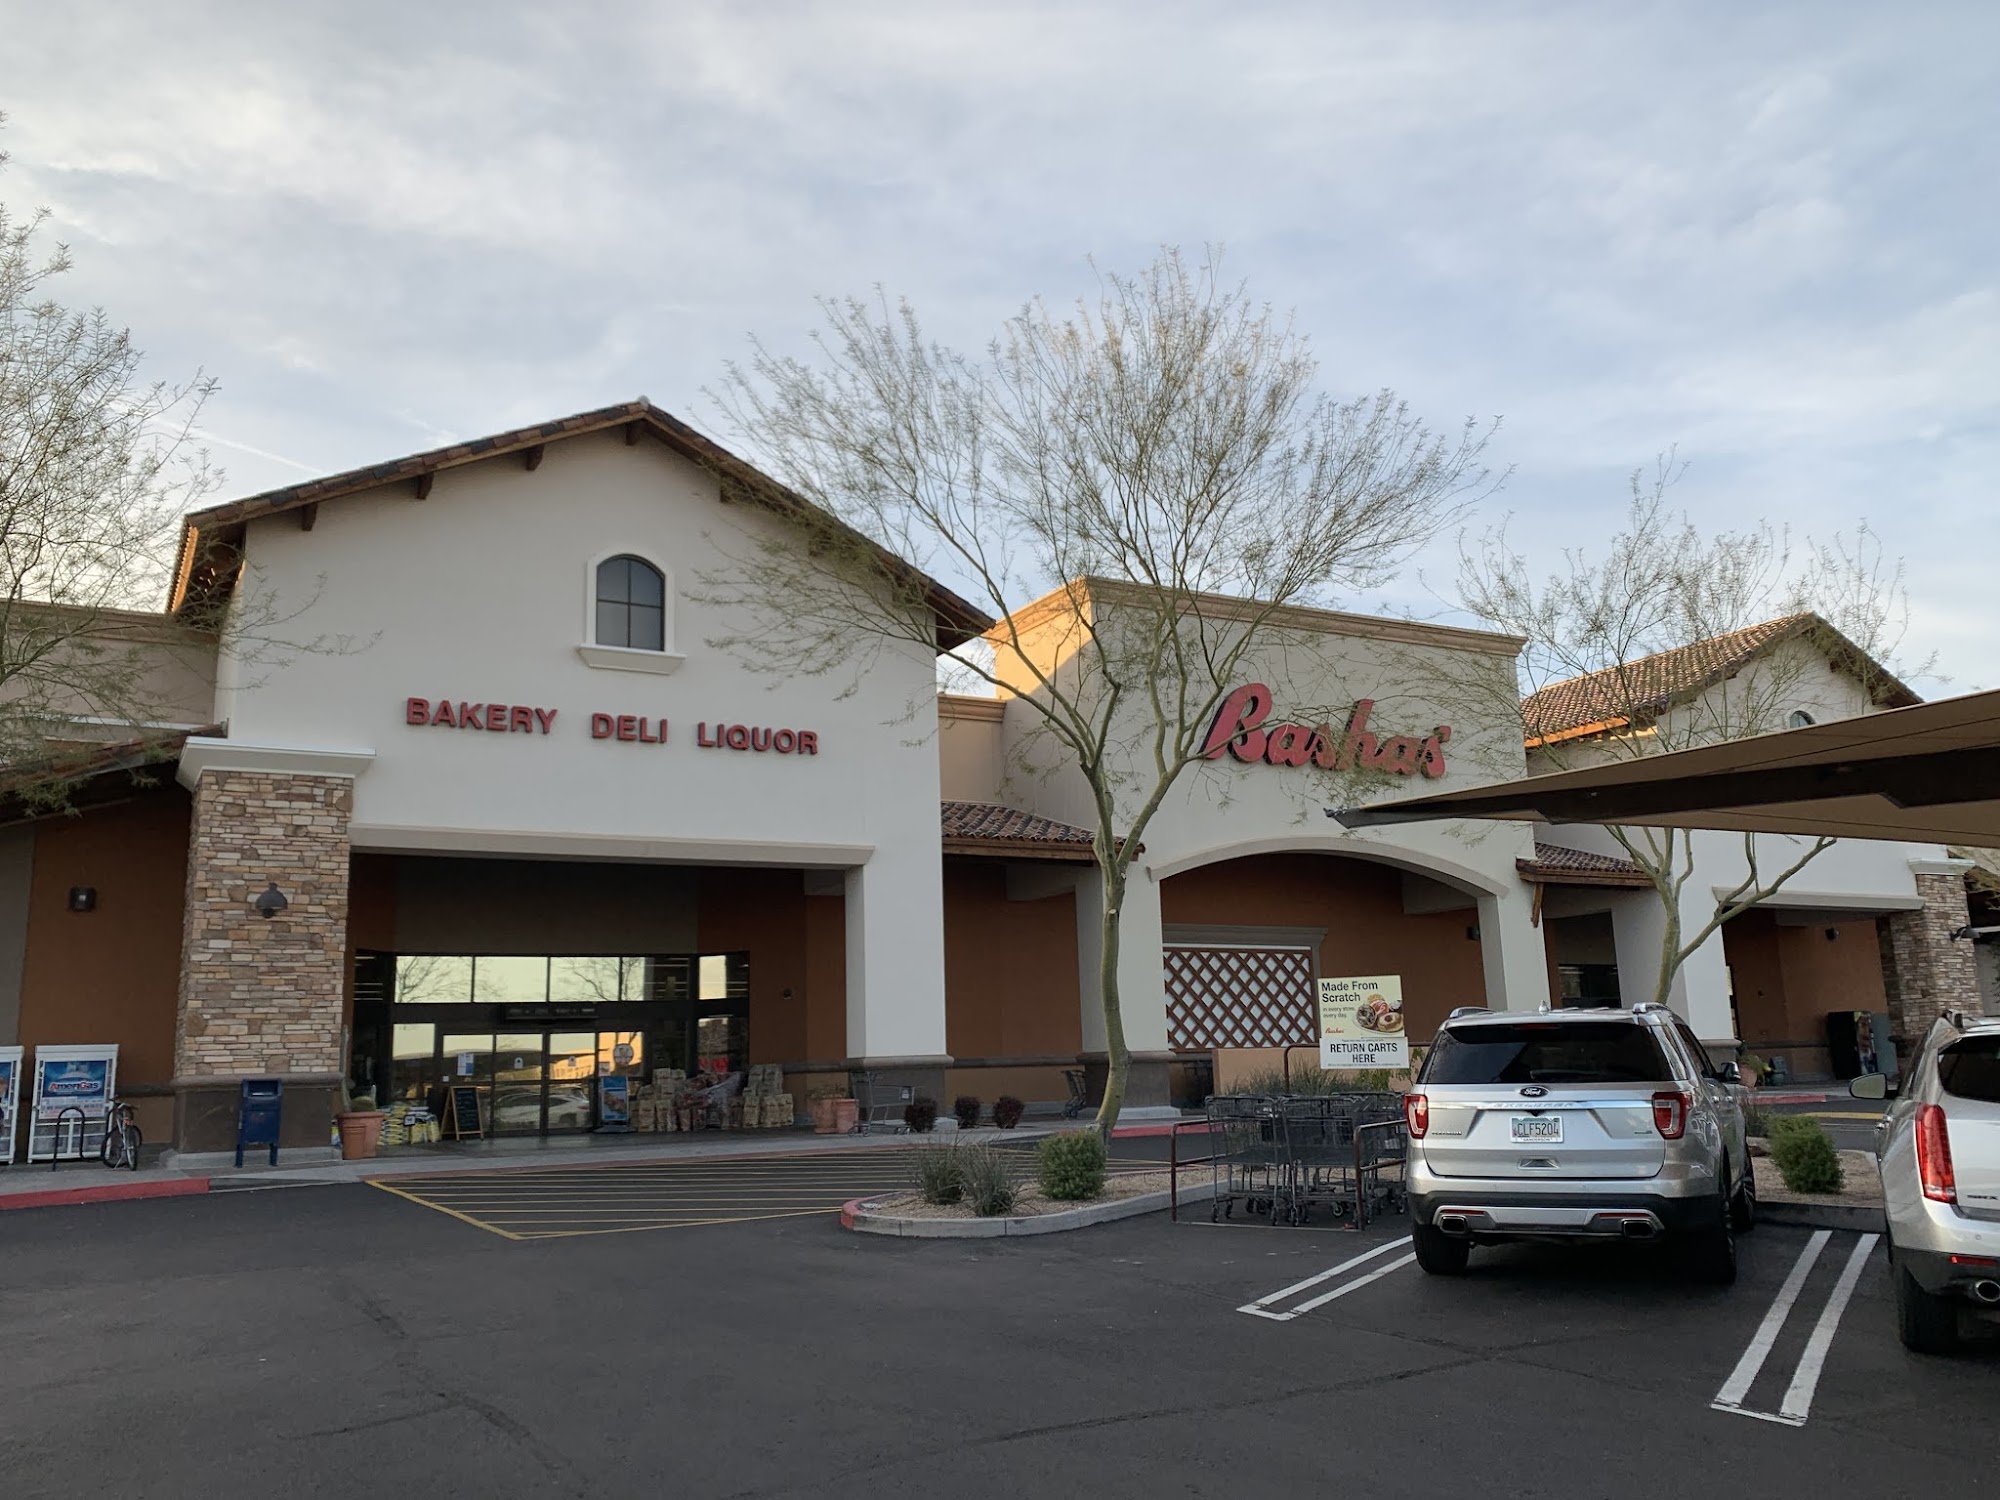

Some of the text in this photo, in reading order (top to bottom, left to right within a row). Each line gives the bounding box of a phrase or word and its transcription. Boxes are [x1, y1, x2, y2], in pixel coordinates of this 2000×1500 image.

[406, 697, 818, 755] BAKERY DELI LIQUOR
[1321, 981, 1378, 992] Made From
[1322, 993, 1361, 1003] Scratch
[1330, 1042, 1398, 1053] RETURN CARTS
[1352, 1053, 1376, 1063] HERE
[49, 1081, 99, 1091] AmeriGas
[1524, 1088, 1541, 1096] Ford
[1517, 1122, 1559, 1136] CLF5204
